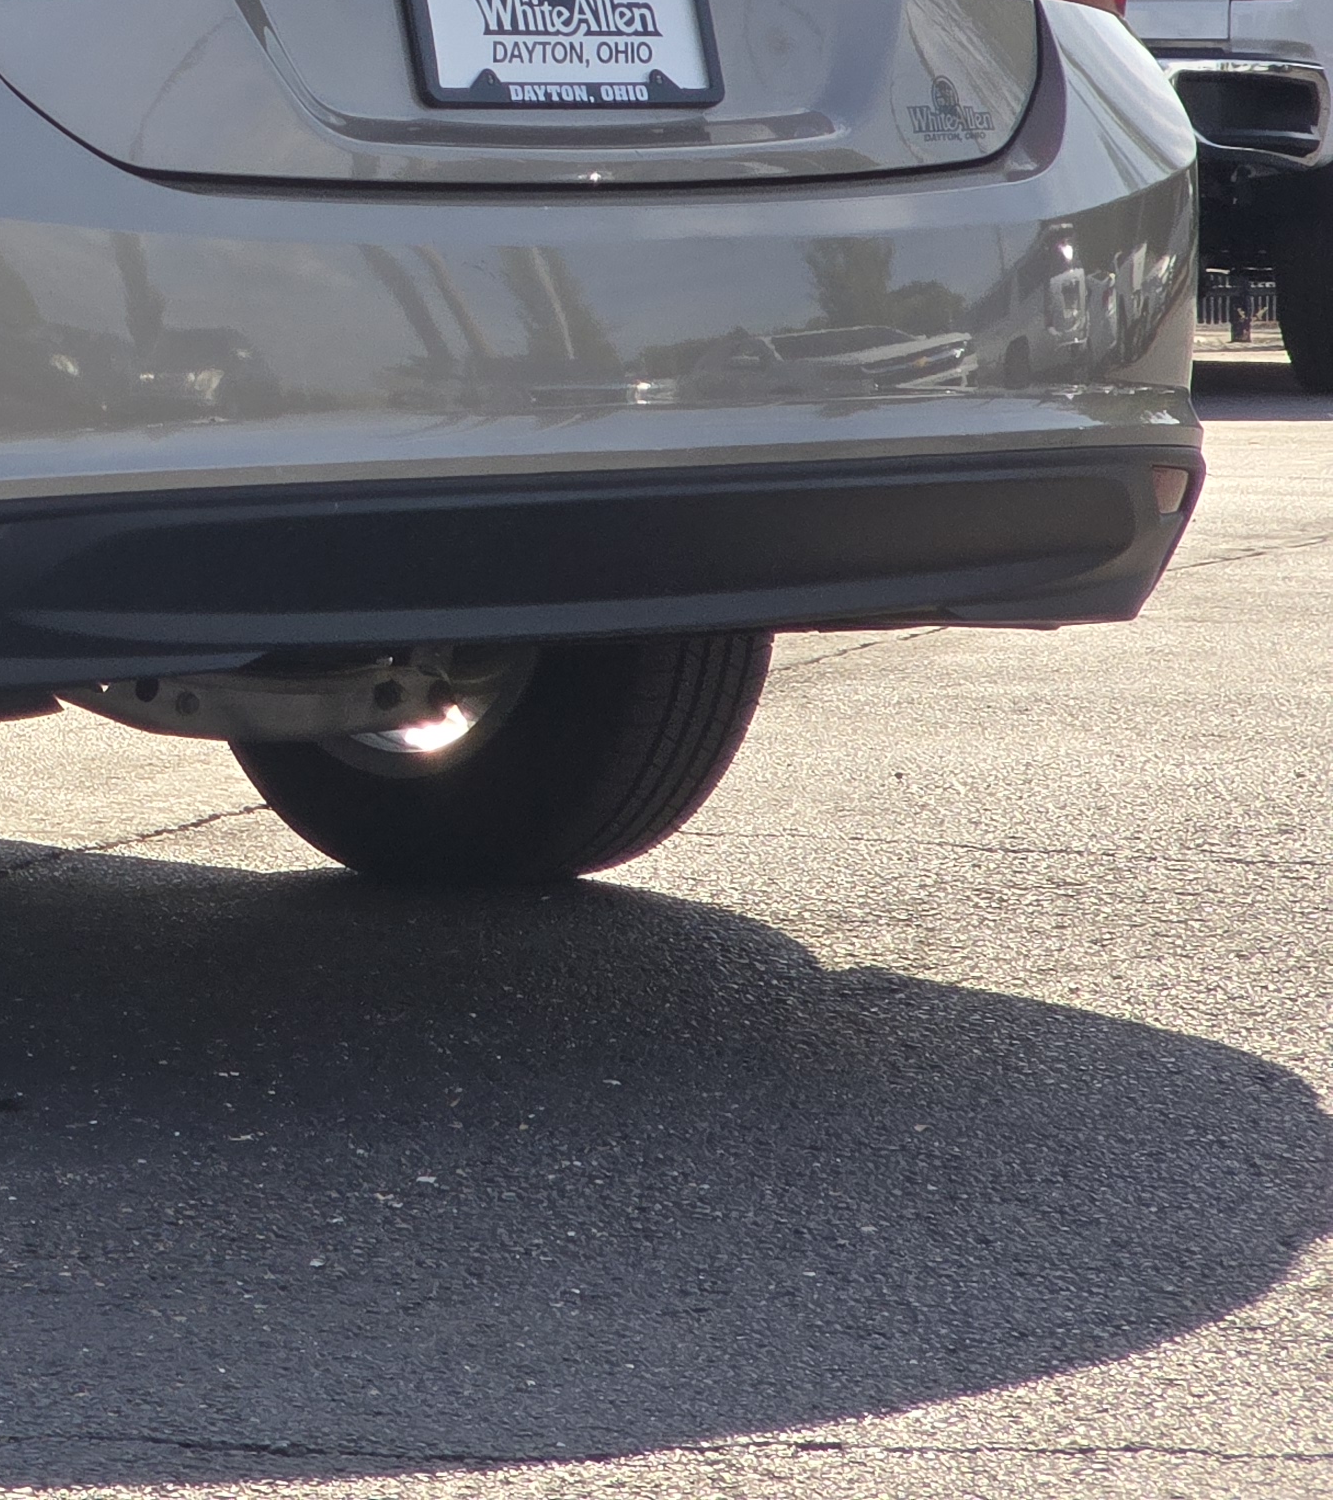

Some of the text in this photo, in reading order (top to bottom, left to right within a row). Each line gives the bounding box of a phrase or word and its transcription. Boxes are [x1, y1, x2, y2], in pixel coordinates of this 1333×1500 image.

[492, 40, 653, 69] DAYTON, OHIO
[509, 84, 650, 104] DAYTON, OHIO
